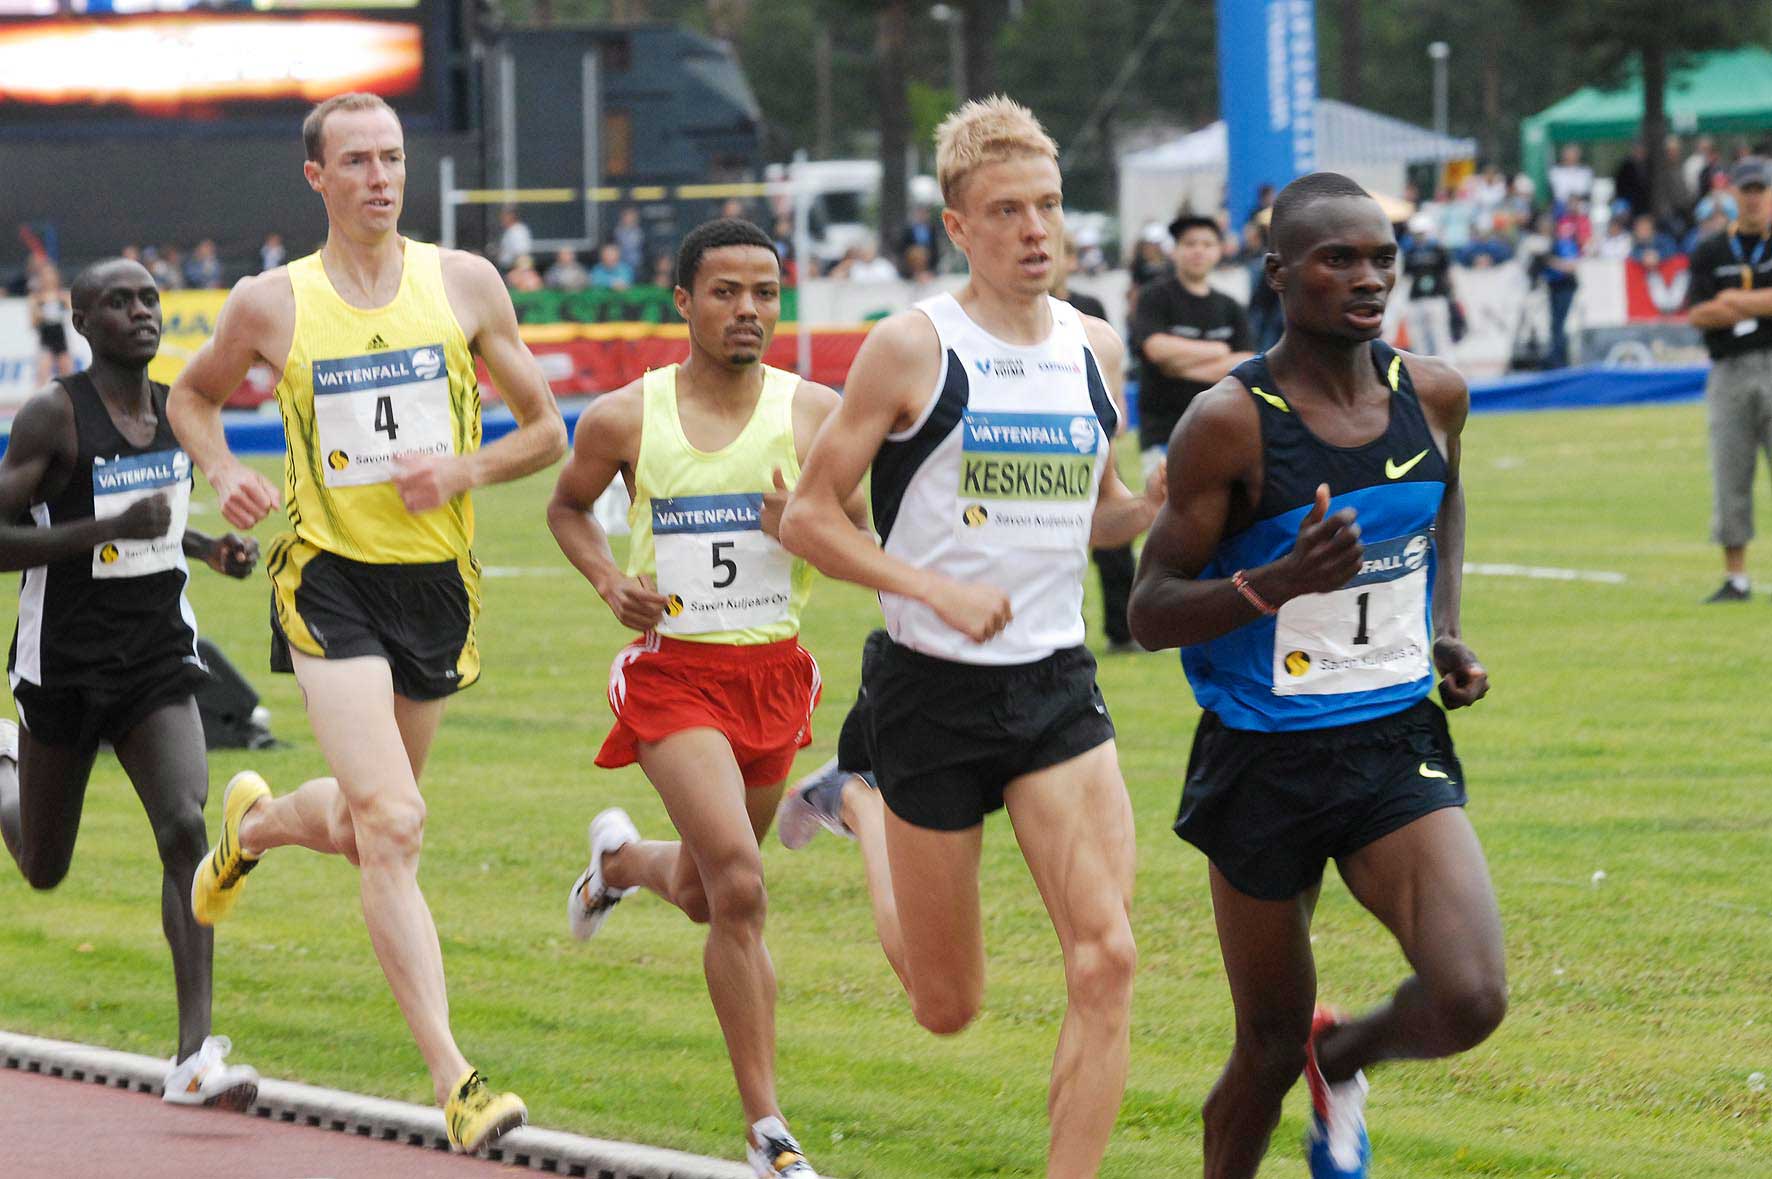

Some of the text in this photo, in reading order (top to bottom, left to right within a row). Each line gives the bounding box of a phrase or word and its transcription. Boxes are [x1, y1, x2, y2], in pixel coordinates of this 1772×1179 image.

[318, 362, 410, 387] VATTENFALL
[374, 395, 399, 441] 4
[969, 424, 1069, 446] VATTENFALL
[98, 464, 171, 488] VATTENFALL
[963, 459, 1091, 498] KESKISALO
[657, 507, 757, 526] VATTENFALL
[711, 540, 738, 589] 5
[690, 600, 723, 613] Savon
[1352, 592, 1370, 645] 1
